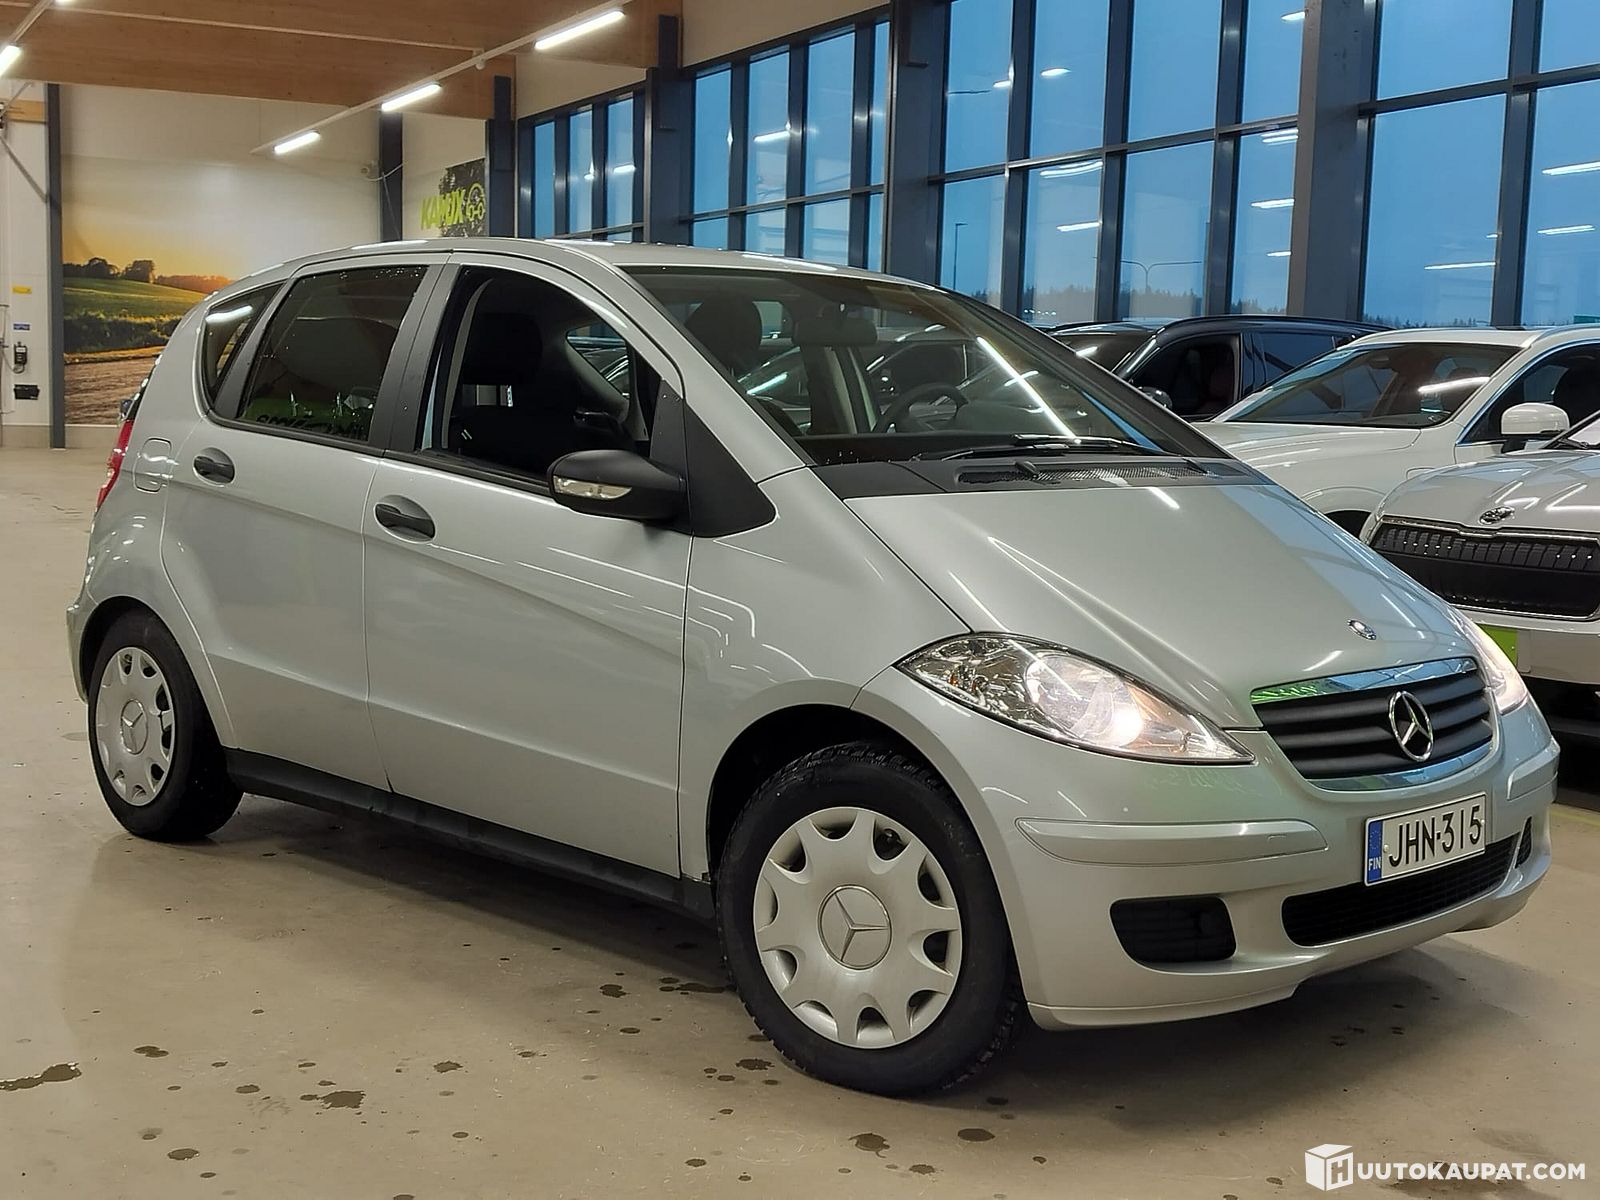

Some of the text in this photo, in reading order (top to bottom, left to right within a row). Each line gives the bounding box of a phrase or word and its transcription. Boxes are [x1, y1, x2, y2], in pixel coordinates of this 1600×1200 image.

[420, 186, 466, 230] KAMUX
[1388, 804, 1482, 868] JHN-315
[1368, 856, 1381, 871] FIN
